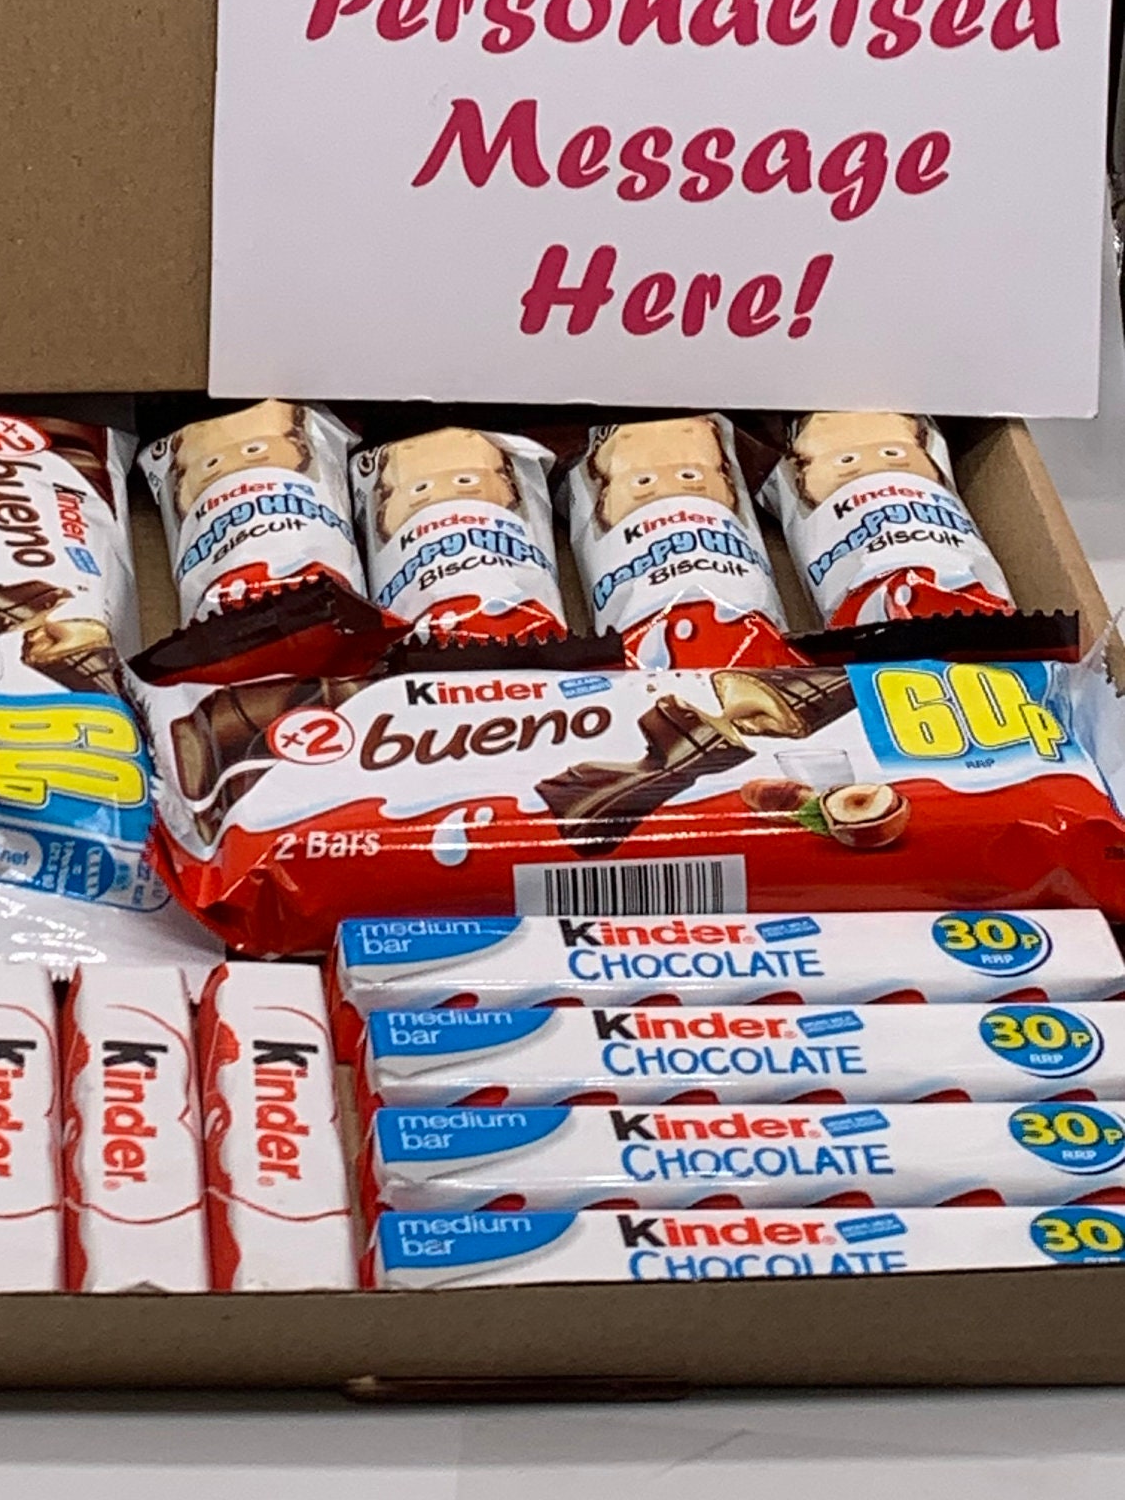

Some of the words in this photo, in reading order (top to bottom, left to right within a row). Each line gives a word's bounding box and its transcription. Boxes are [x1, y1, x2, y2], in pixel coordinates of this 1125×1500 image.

[412, 98, 953, 222] Message
[519, 244, 835, 340] Here!
[52, 482, 90, 545] Kinder
[195, 482, 277, 520] Kinder
[833, 485, 926, 520] Kinder
[212, 517, 307, 564] Biscuit
[400, 513, 490, 550] Kinder
[624, 511, 717, 545] Kinder
[867, 529, 964, 553] Biscuit
[648, 558, 749, 586] Biscuit
[405, 678, 548, 706] Kinder
[874, 663, 1067, 761] 60p
[359, 705, 613, 770] bueno
[276, 834, 296, 861] 2
[306, 830, 380, 859] Bars
[359, 919, 481, 936] medium
[559, 919, 747, 947] Kinder
[362, 936, 412, 955] bar
[980, 953, 1015, 965] RRP
[568, 949, 825, 982] CHOCOLATE
[387, 1010, 513, 1026] medium
[593, 1009, 787, 1041] Kinder
[389, 1029, 442, 1046] bar
[602, 1042, 867, 1077] CHOCOLATE
[1029, 1052, 1064, 1064] RRP
[102, 1040, 168, 1183] Kinder
[252, 1040, 319, 1181] Kinder
[397, 1111, 528, 1131] medium
[609, 1110, 809, 1141] Kinder
[400, 1133, 454, 1151] bar
[1061, 1149, 1097, 1162] RRP
[621, 1143, 896, 1182] CHOCOLATE
[397, 1214, 532, 1235] medium
[617, 1214, 825, 1248] Kinder
[400, 1237, 455, 1257] bar
